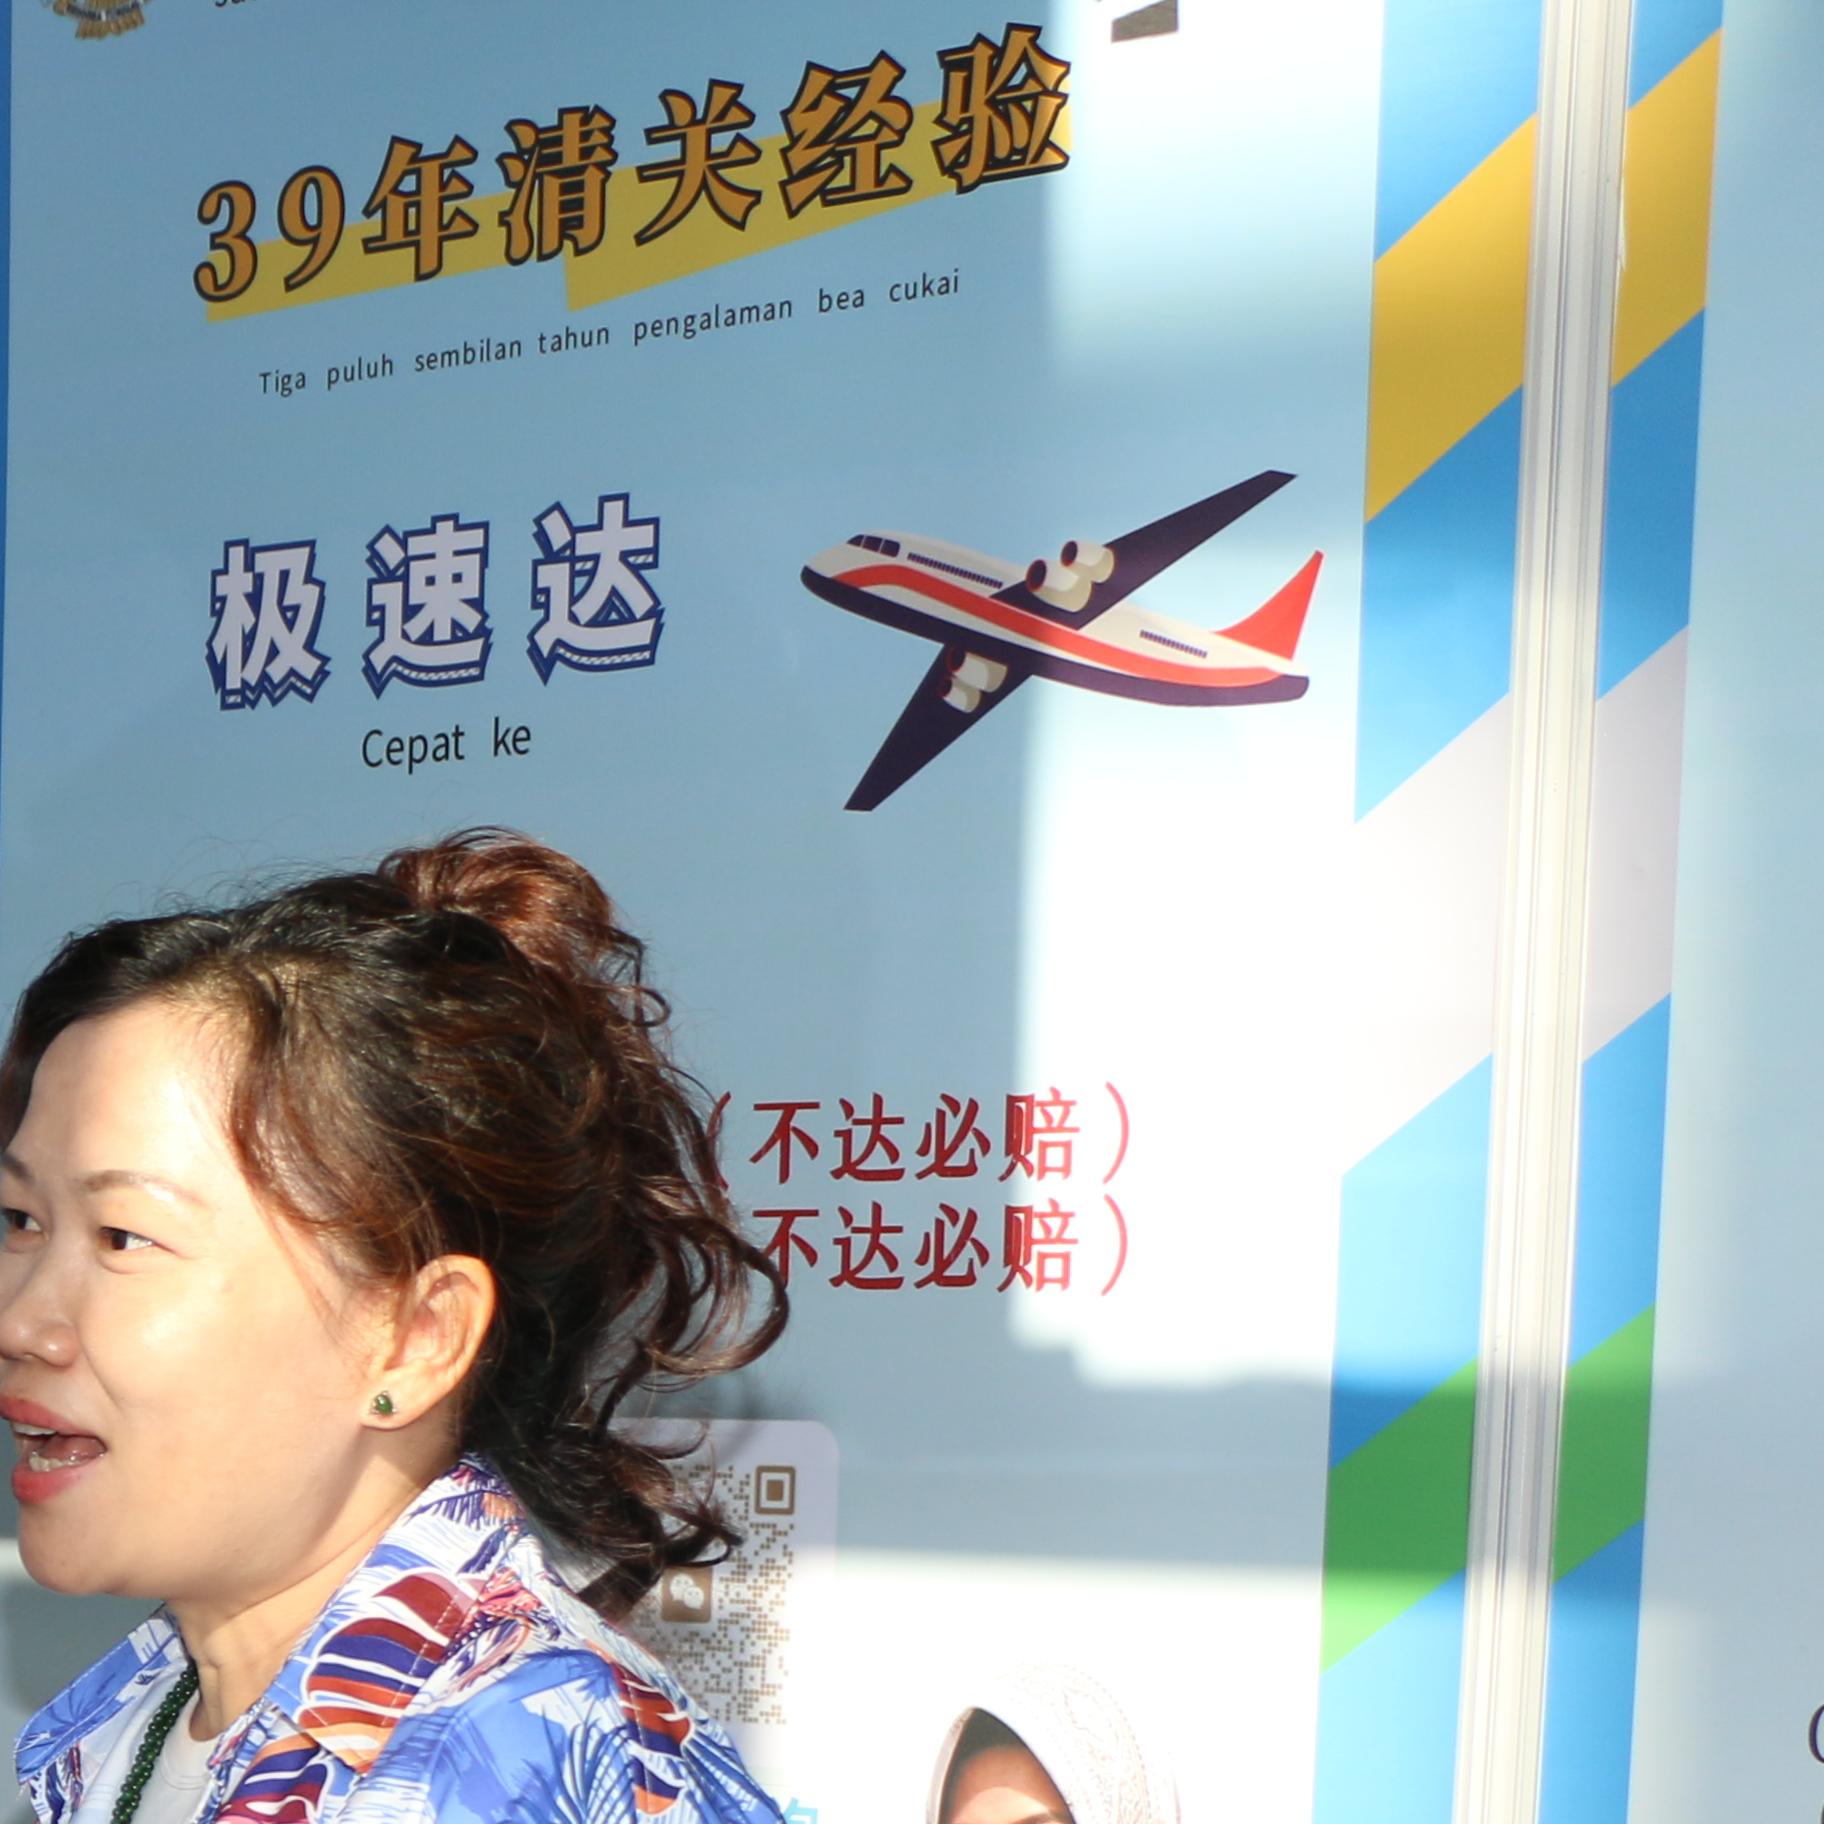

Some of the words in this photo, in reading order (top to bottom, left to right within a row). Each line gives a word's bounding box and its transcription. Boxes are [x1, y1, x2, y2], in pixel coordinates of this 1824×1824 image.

[192, 23, 1072, 303] 39年清关经验
[260, 370, 306, 398] Tiga
[327, 354, 394, 390] puluh
[414, 337, 522, 373] sembilan
[538, 322, 610, 354] tahun
[634, 296, 793, 345] pengalaman
[818, 287, 865, 313] bea
[889, 269, 960, 304] cukai
[205, 491, 661, 712] 极速达
[361, 724, 466, 775] Cepat
[491, 716, 532, 759] ke
